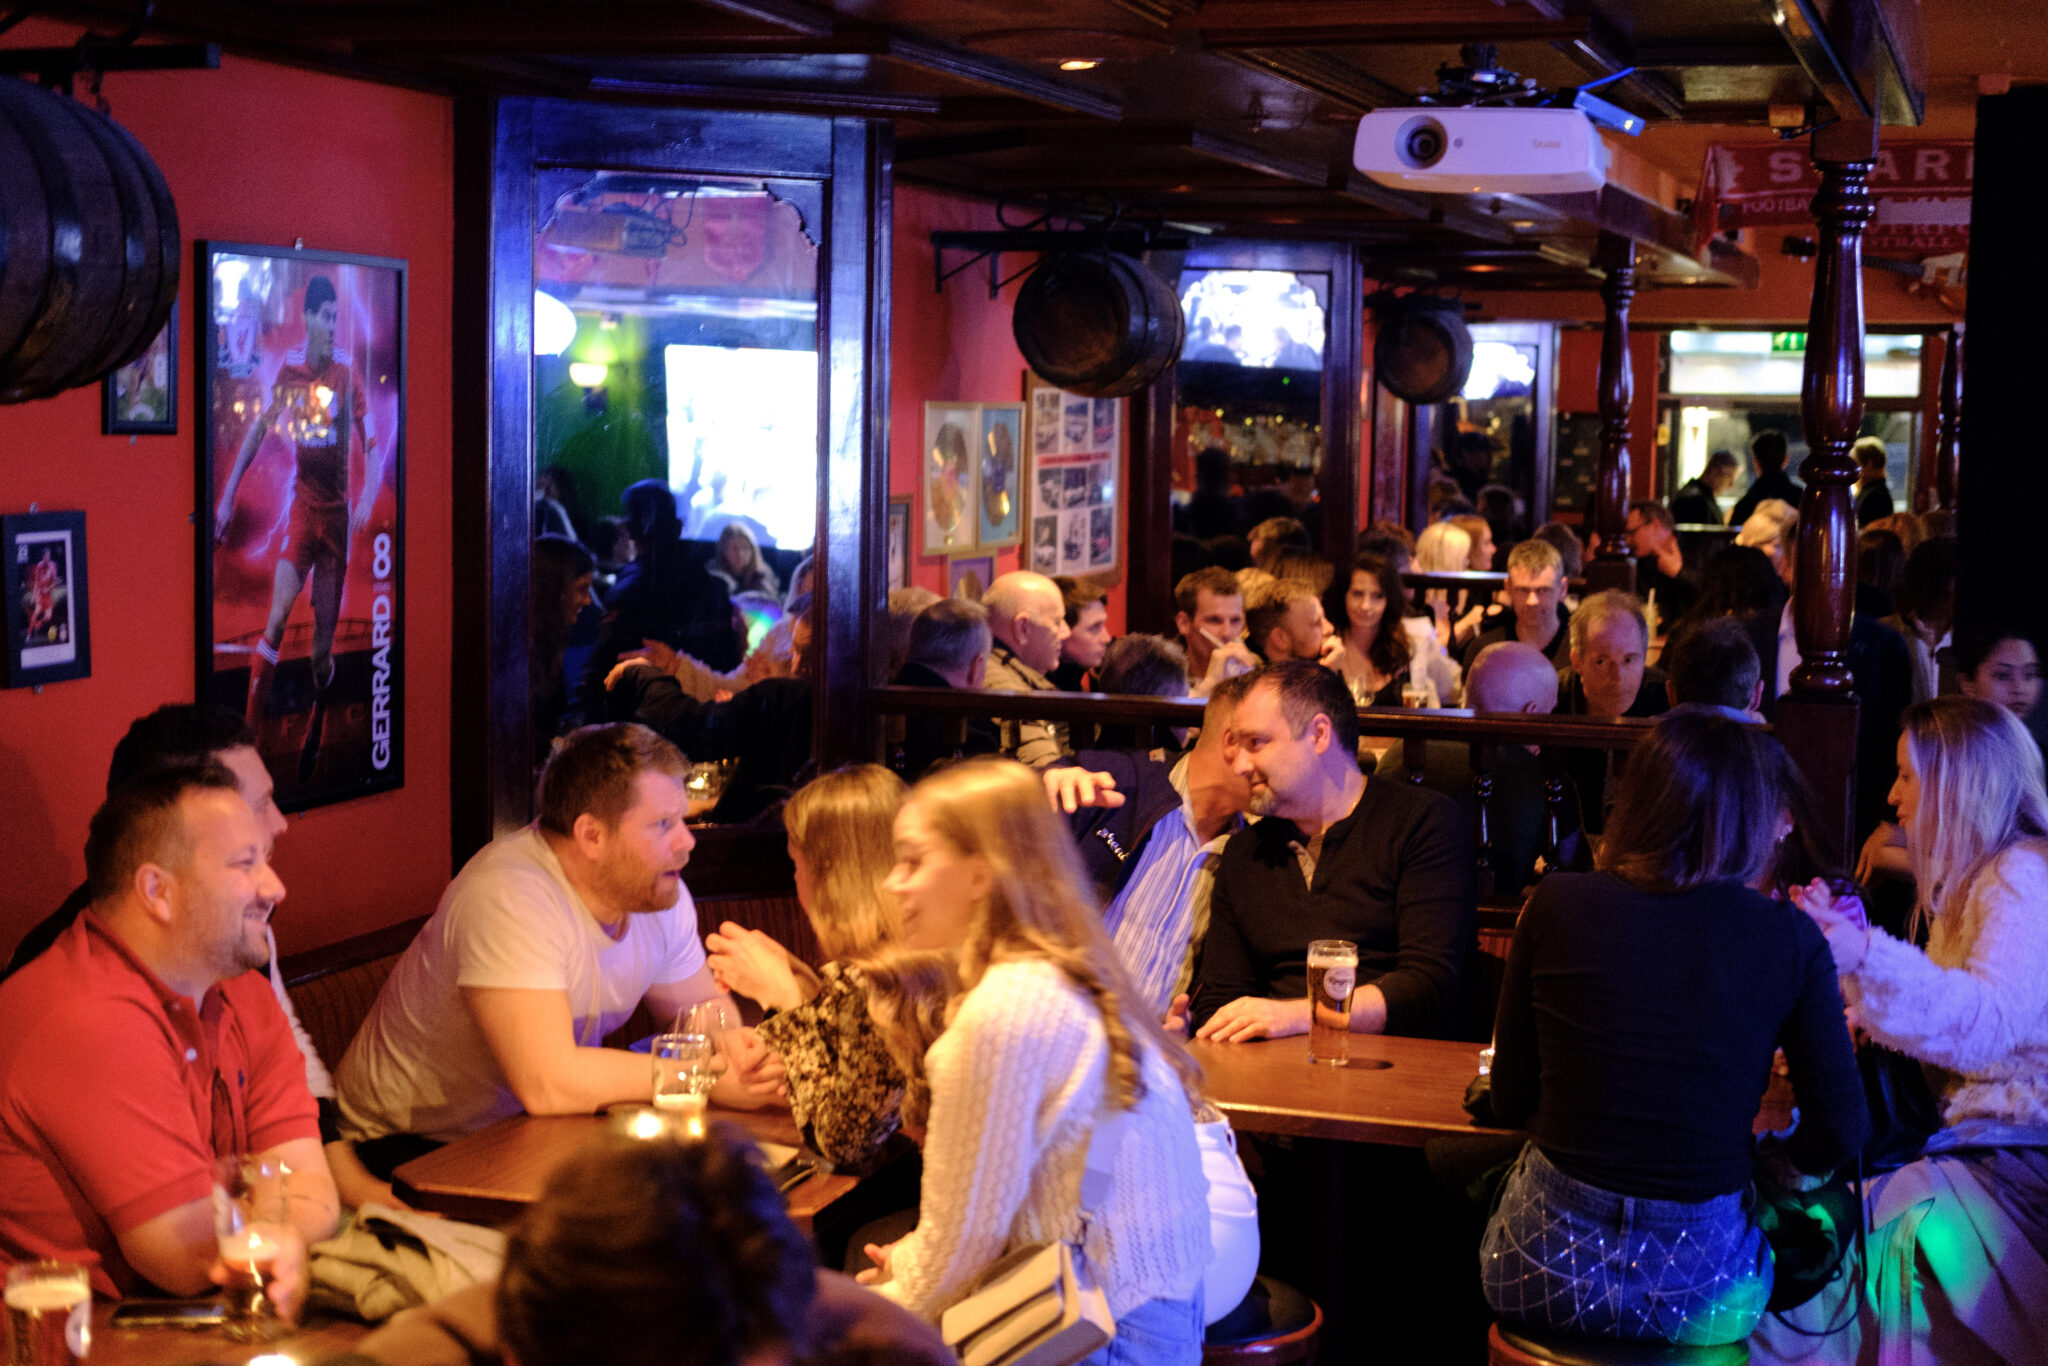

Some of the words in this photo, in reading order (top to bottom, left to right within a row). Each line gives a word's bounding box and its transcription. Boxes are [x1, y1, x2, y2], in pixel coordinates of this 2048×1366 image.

[1742, 197, 1810, 213] FOOTBA
[373, 533, 391, 580] 8
[372, 595, 391, 770] GERRARD
